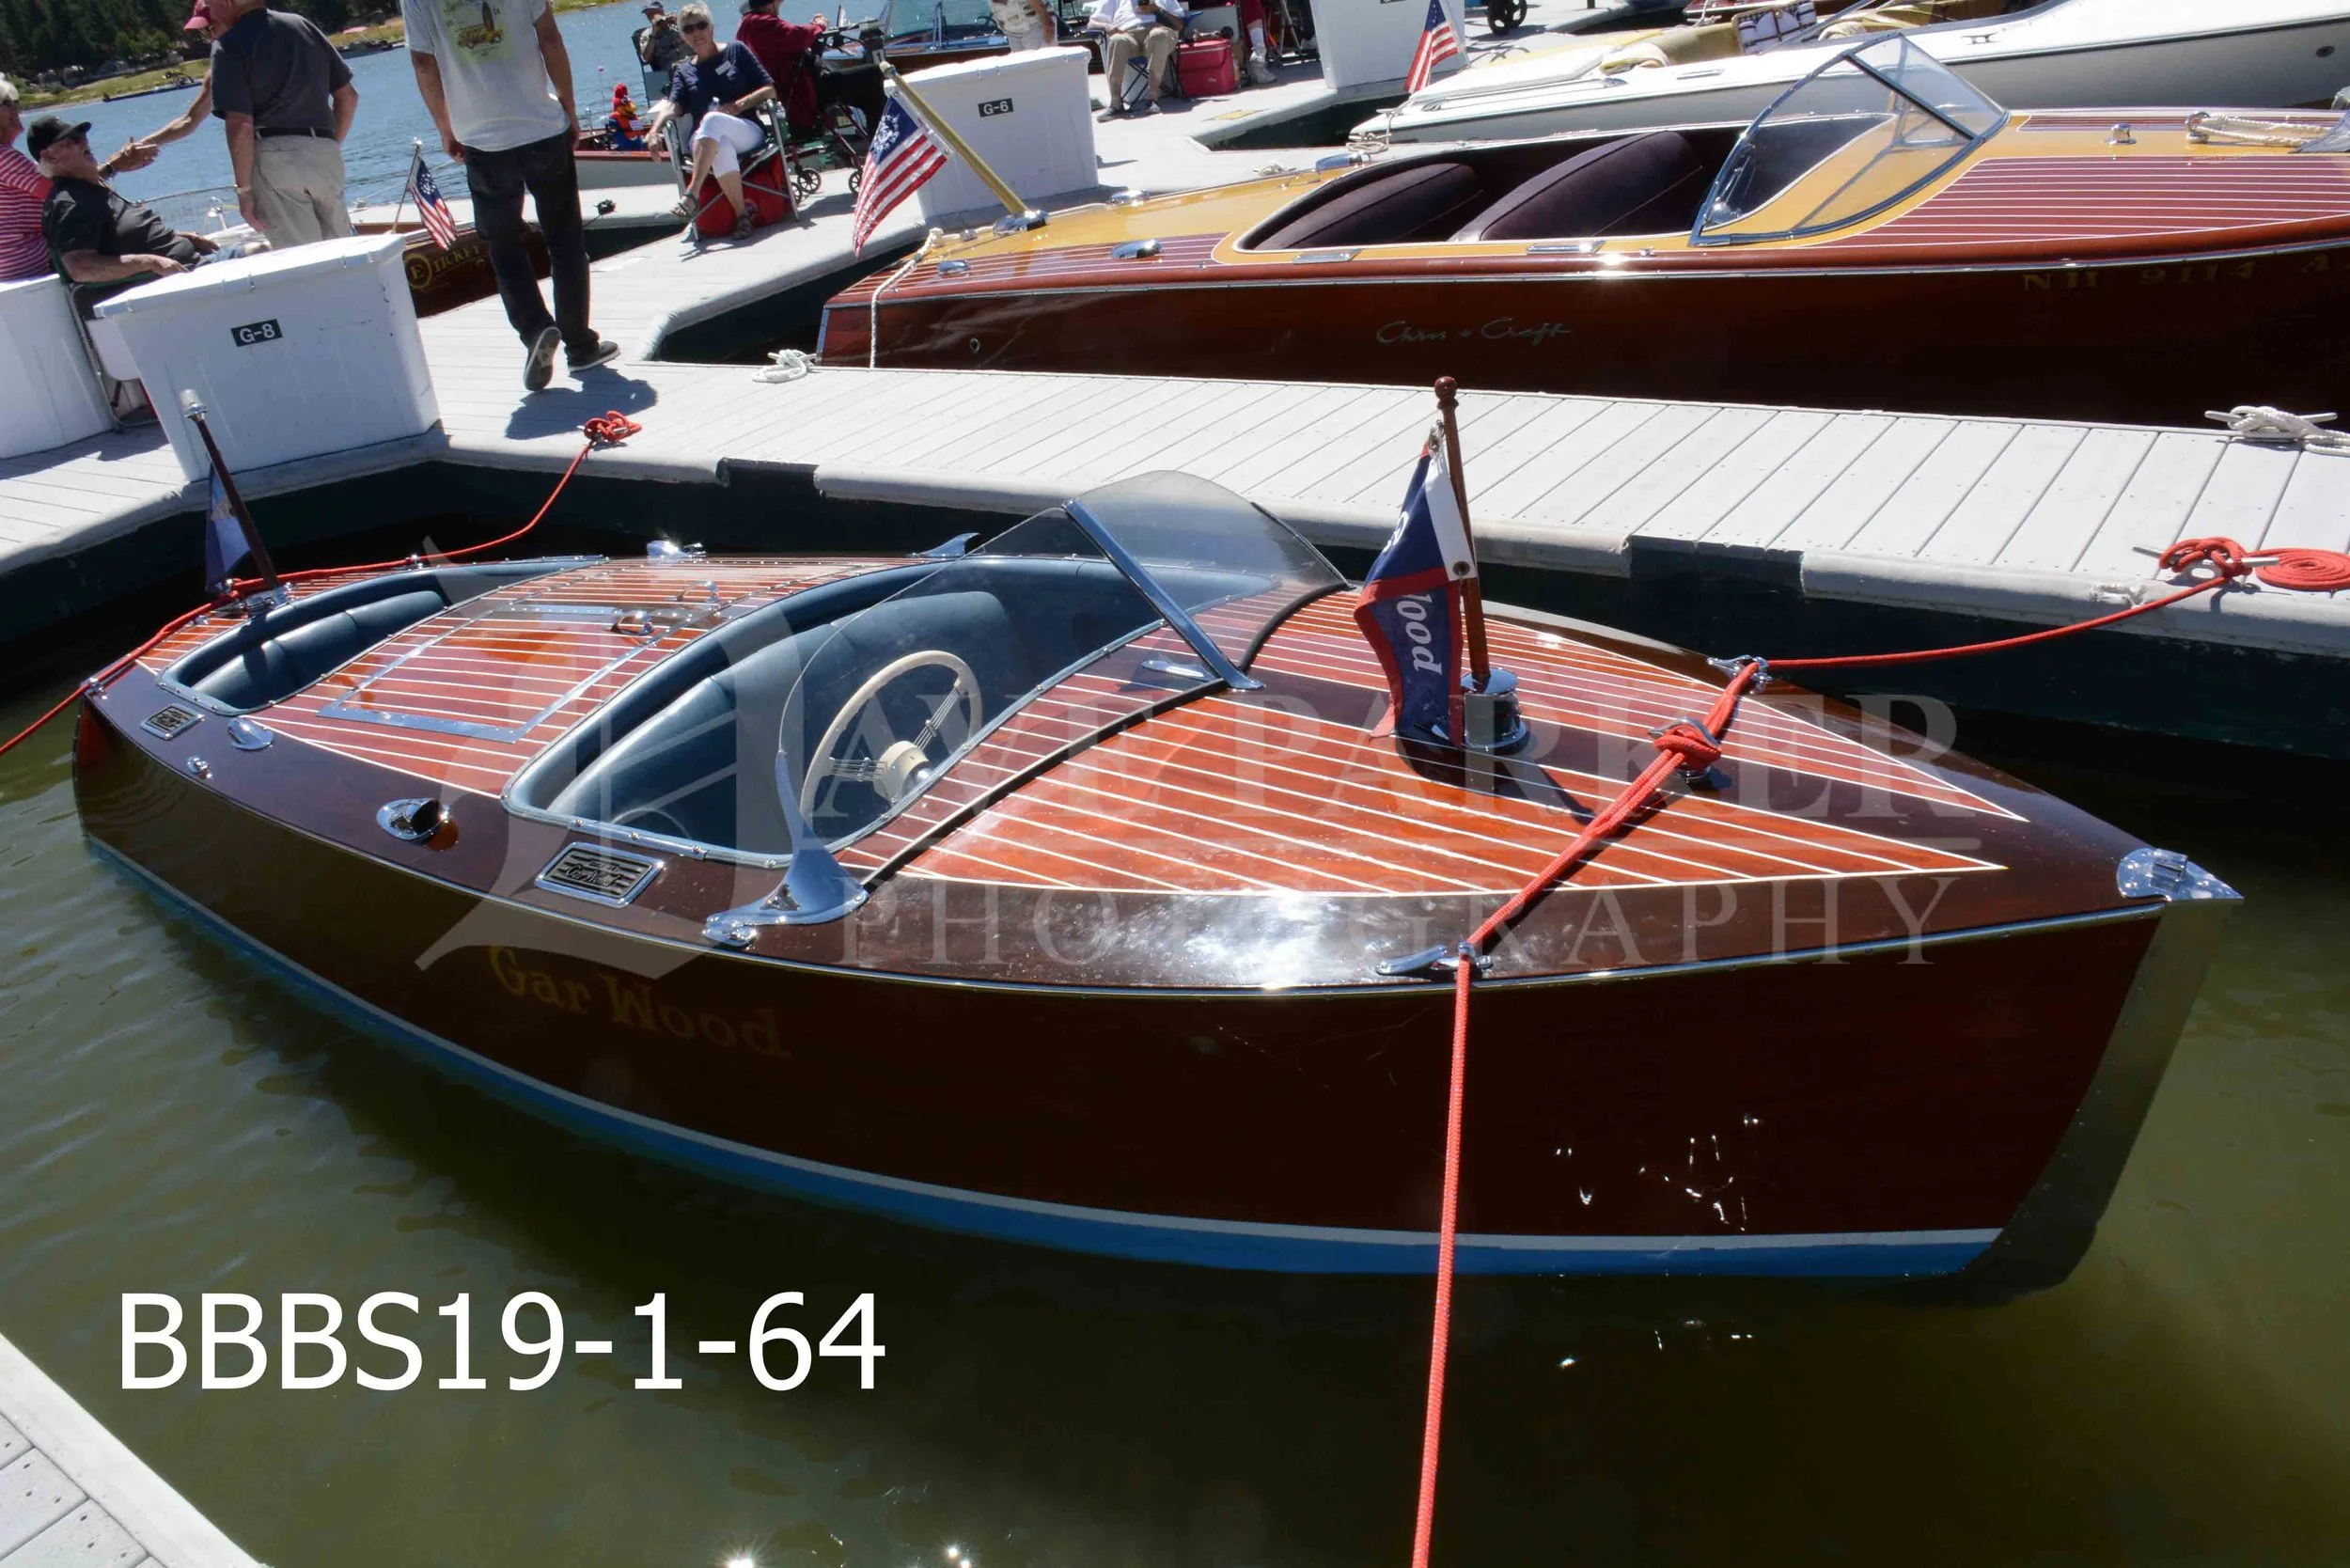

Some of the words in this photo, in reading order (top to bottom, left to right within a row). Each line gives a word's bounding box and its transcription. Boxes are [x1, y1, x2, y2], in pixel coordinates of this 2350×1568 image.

[983, 101, 1009, 115] G-6
[433, 244, 481, 272] TICKET
[2138, 260, 2256, 286] 9114
[240, 323, 275, 343] G-8
[1480, 316, 1573, 346] Craft
[489, 943, 591, 1015] Gar
[597, 972, 793, 1060] Wood
